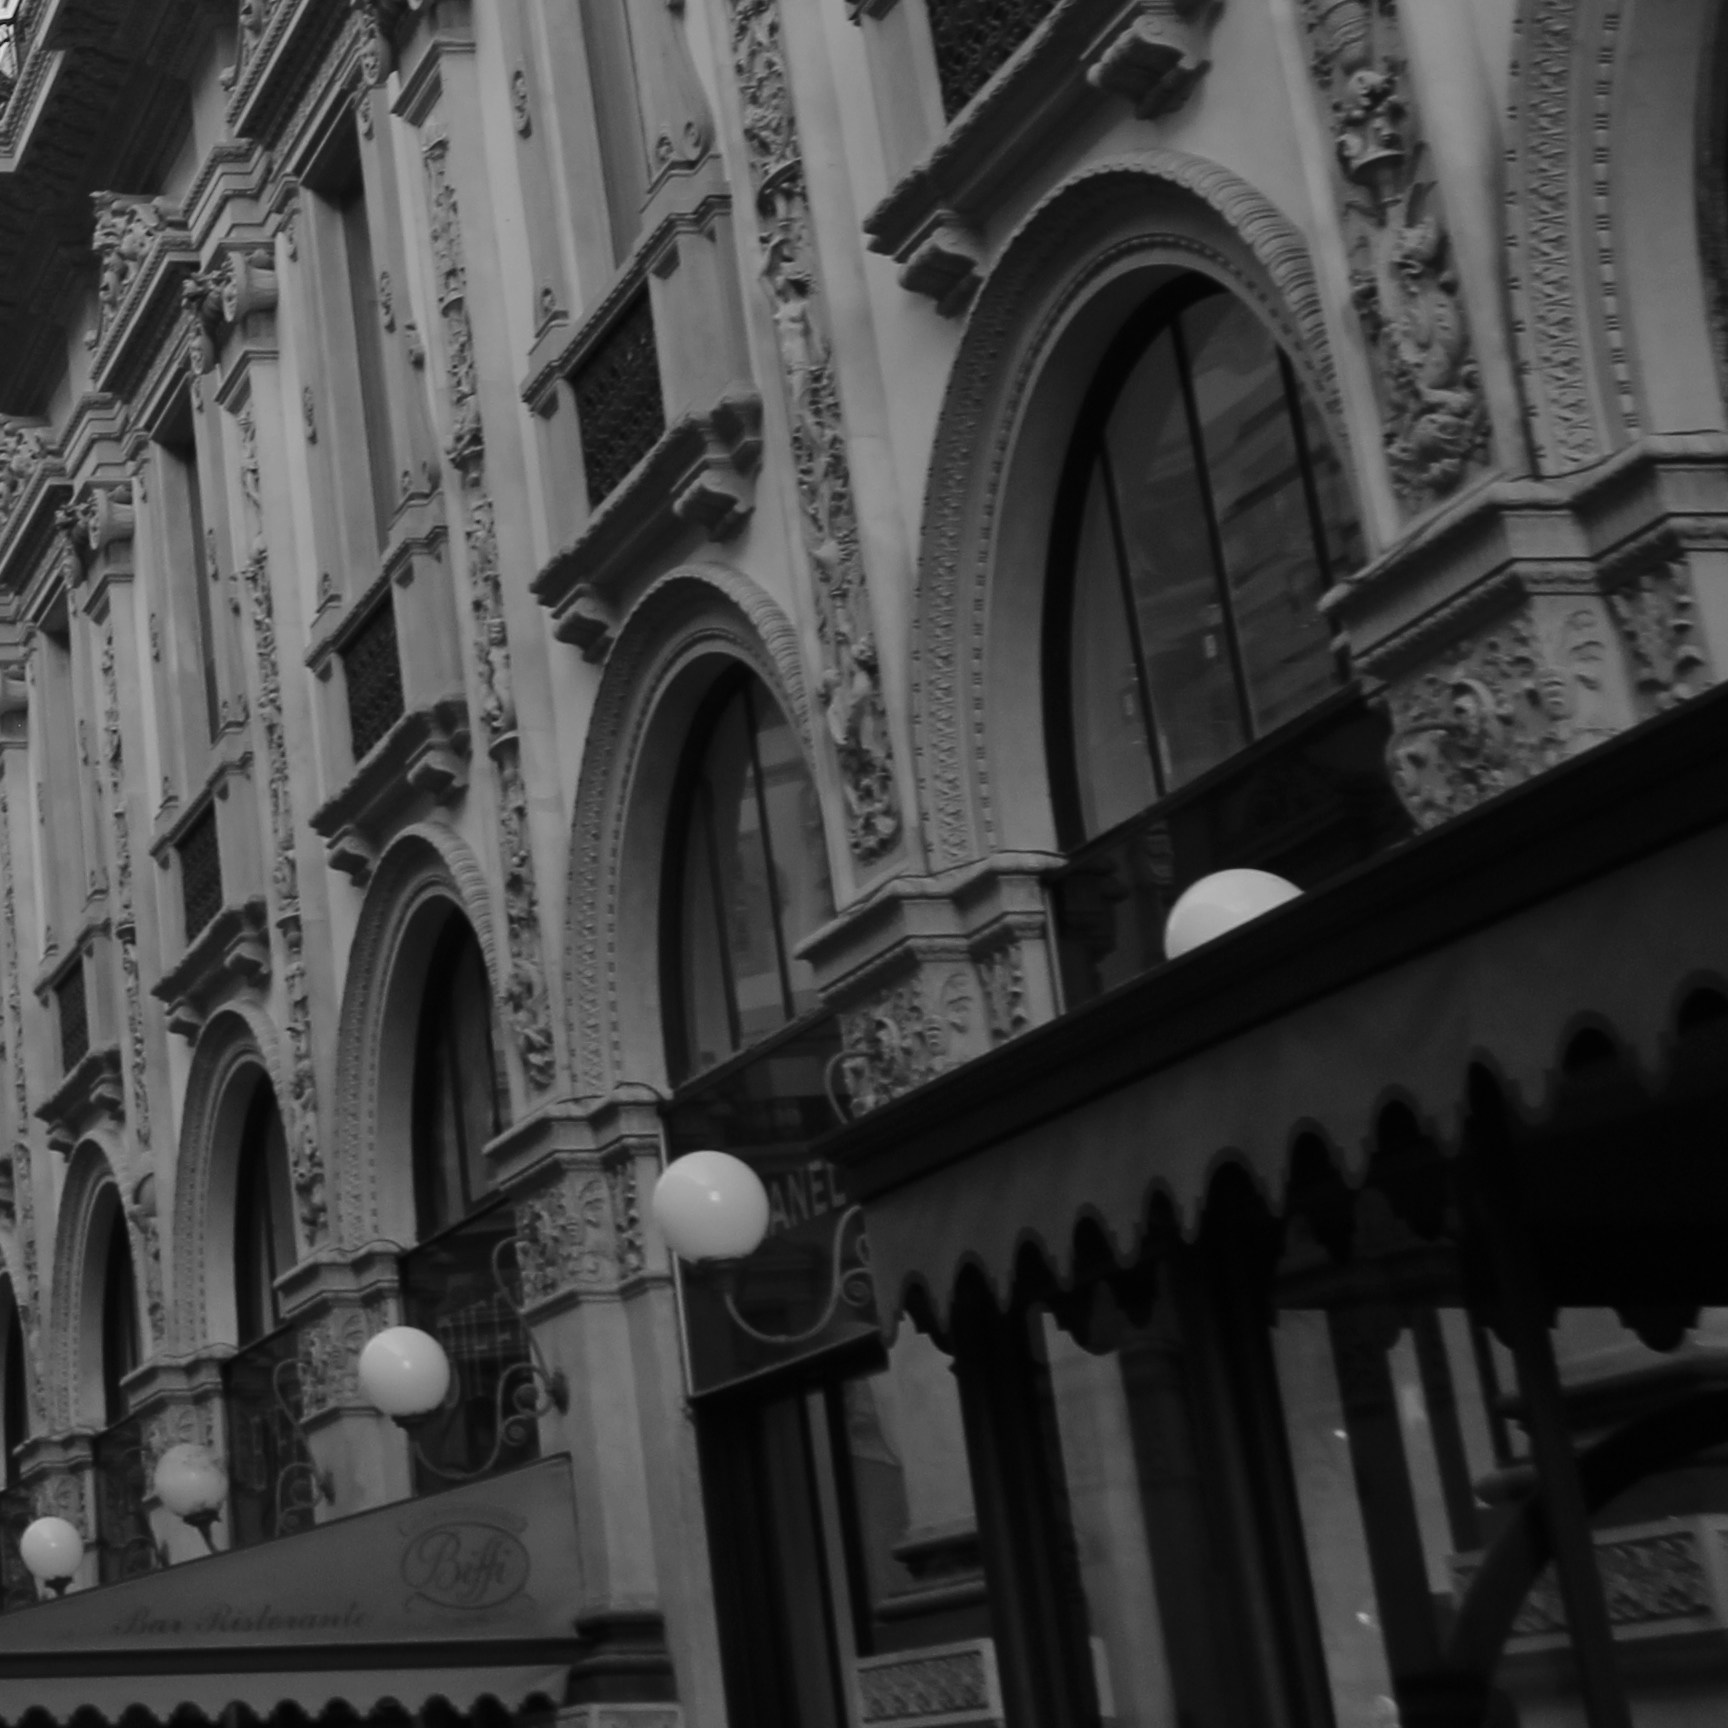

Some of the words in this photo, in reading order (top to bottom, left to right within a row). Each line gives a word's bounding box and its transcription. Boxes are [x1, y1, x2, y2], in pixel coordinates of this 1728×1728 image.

[412, 1529, 512, 1604] Biffi
[112, 1604, 182, 1636] Bar
[196, 1600, 366, 1633] Ristorante
